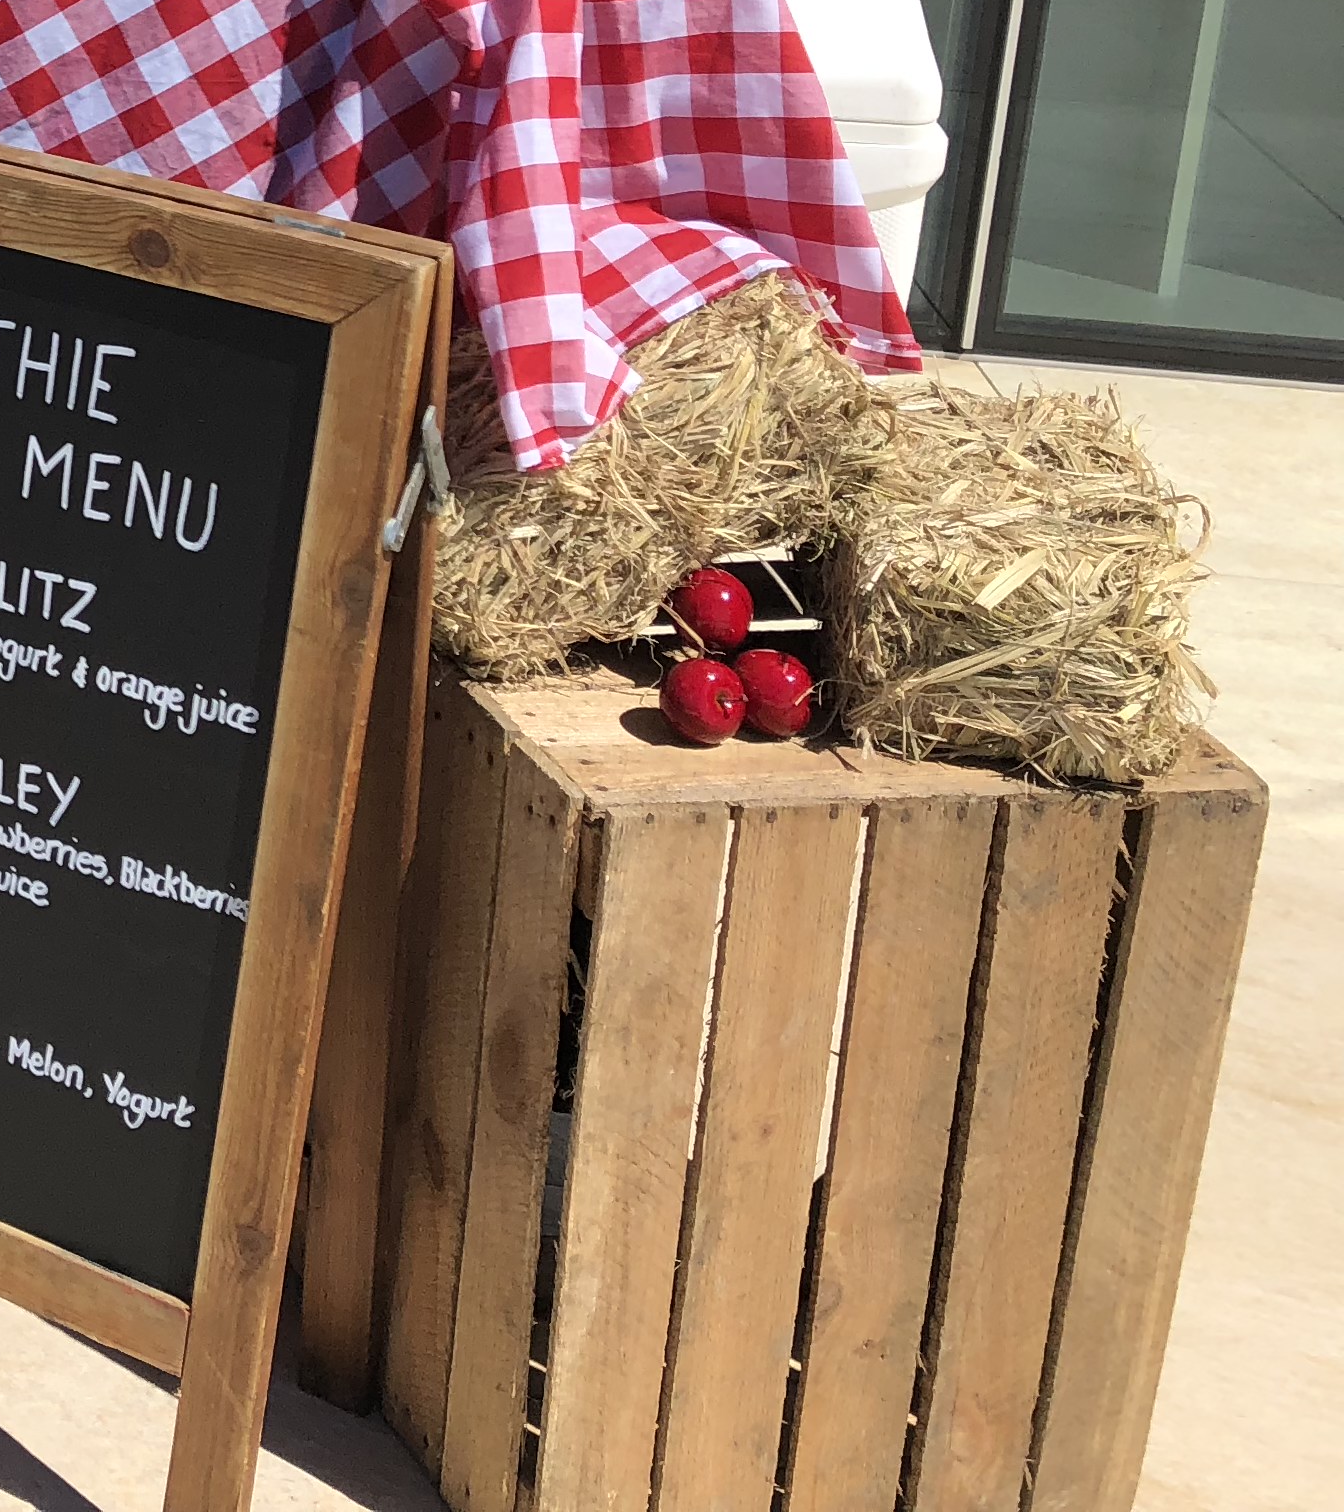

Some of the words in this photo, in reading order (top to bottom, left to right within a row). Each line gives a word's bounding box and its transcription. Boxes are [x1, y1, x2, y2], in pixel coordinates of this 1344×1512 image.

[21, 434, 218, 552] MENU
[71, 655, 89, 689] &
[95, 664, 185, 732] orange
[176, 683, 260, 735] juice
[7, 1035, 94, 1099] Melon,
[102, 1070, 196, 1130] Yogurt
